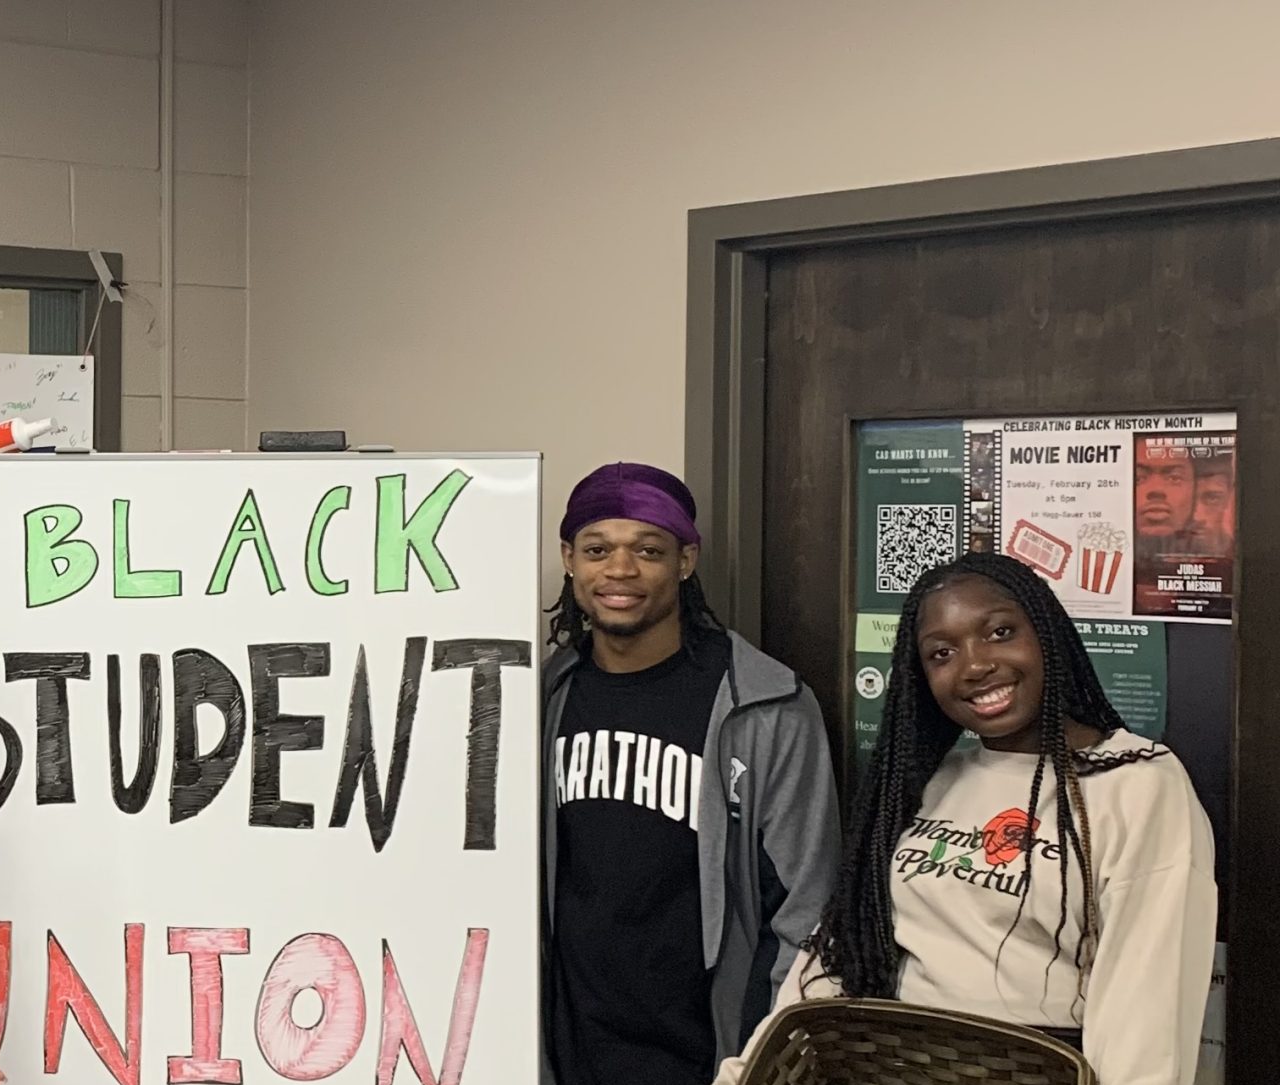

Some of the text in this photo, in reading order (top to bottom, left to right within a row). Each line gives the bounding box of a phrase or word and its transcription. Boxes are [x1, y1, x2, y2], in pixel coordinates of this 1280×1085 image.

[1003, 416, 1203, 433] CELEBRATING BLACK HISTORY MONTH
[1009, 445, 1122, 465] MOVIE NIGHT
[1006, 479, 1046, 490] Tuesday,
[1049, 479, 1092, 490] February
[22, 468, 473, 609] BLACK
[1176, 563, 1205, 575] JUDAS
[1157, 579, 1222, 593] BLACK MESSIAH
[1094, 623, 1149, 637] TREATS
[907, 814, 997, 855] Women
